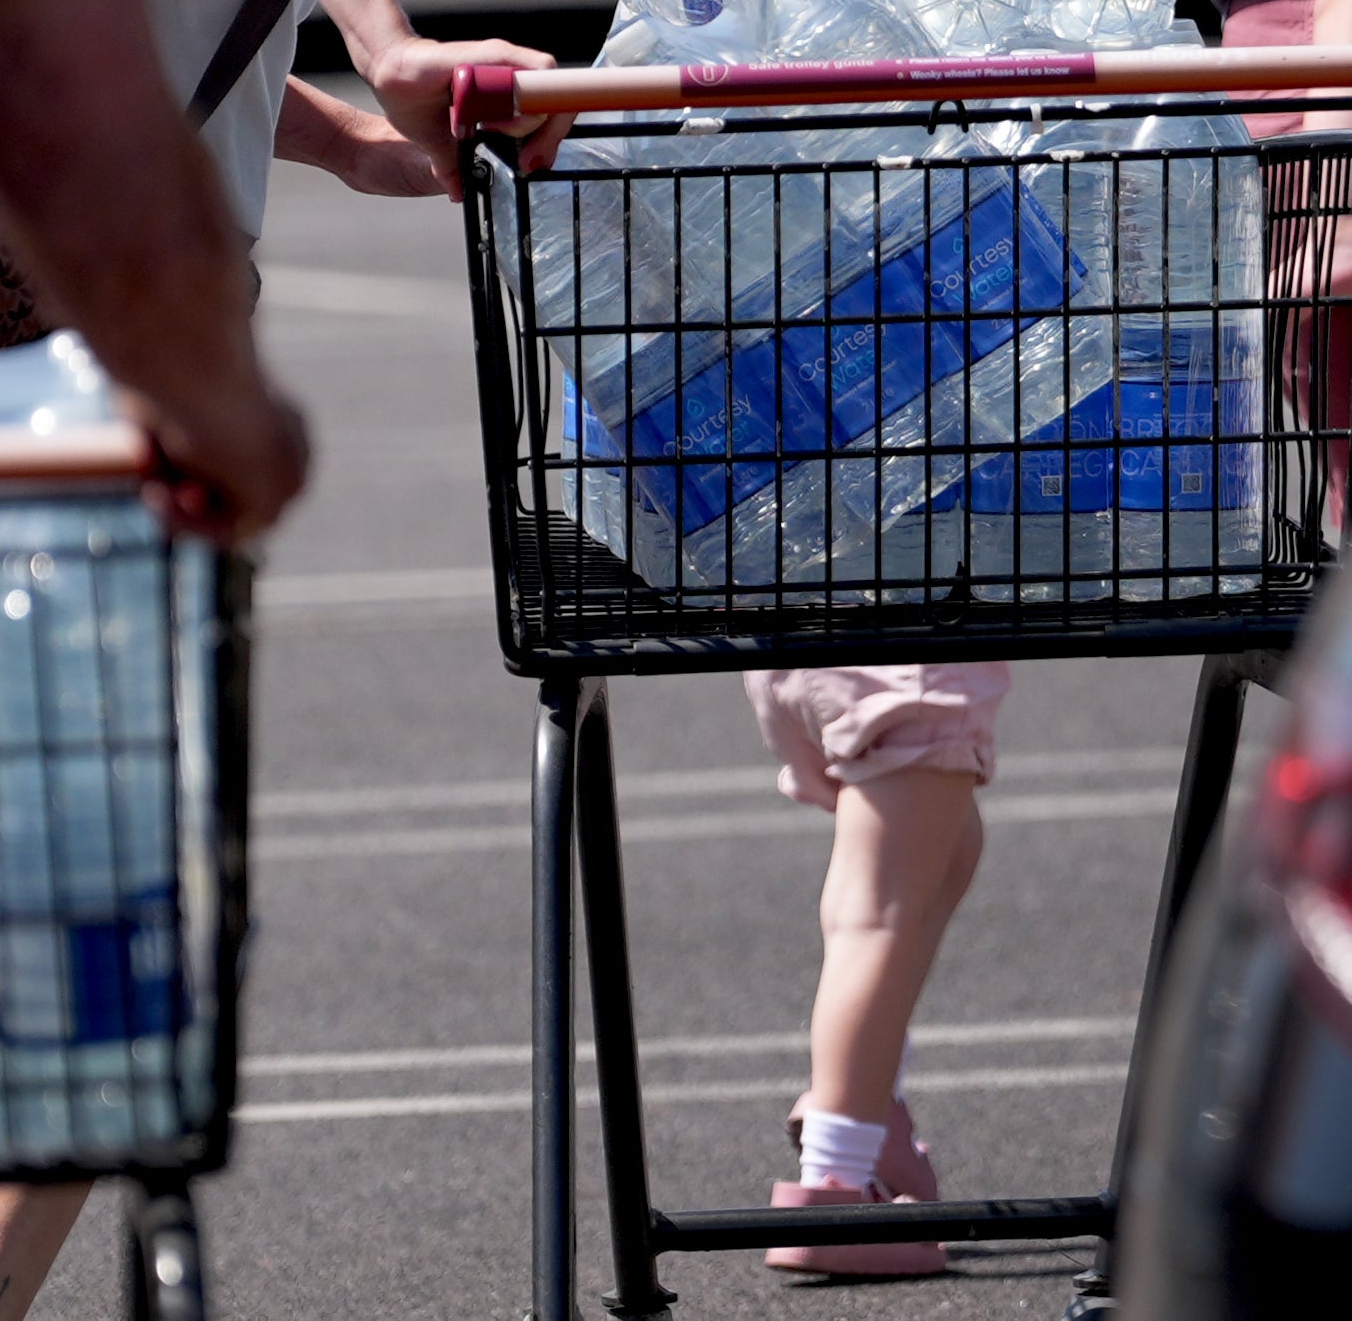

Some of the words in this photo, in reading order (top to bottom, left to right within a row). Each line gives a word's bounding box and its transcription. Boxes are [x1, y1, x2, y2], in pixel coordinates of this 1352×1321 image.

[783, 60, 829, 70] trolley
[832, 59, 875, 70] guide
[908, 70, 943, 81] Wonky
[983, 67, 1015, 78] Please
[1016, 66, 1029, 76] let
[1043, 66, 1070, 76] know
[1120, 448, 1246, 477] CARRG
